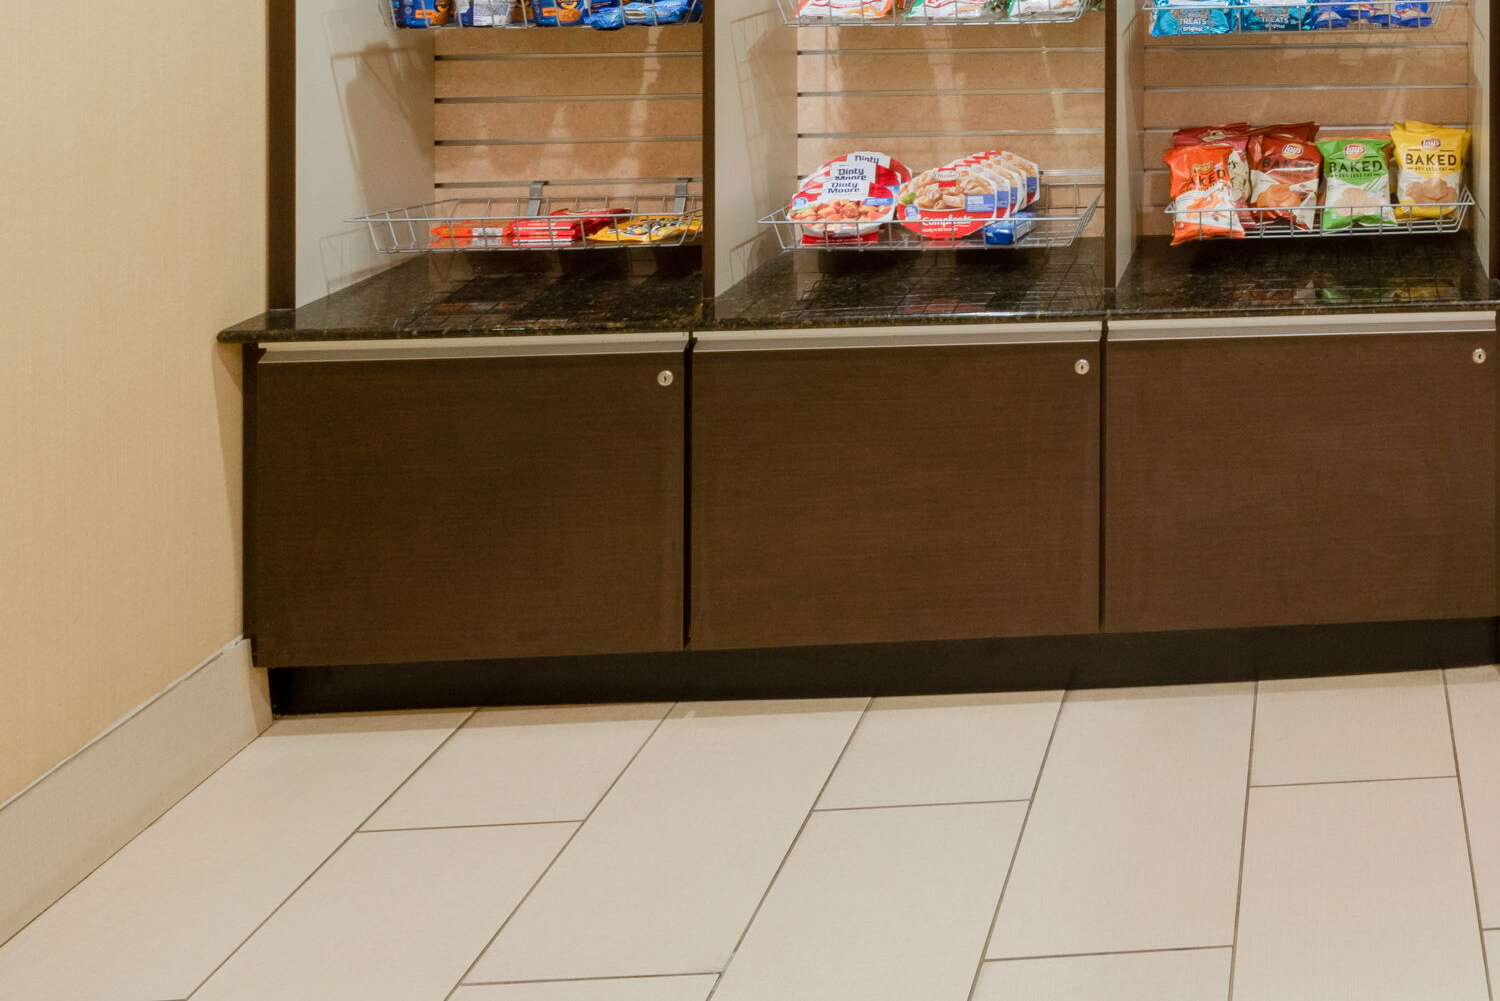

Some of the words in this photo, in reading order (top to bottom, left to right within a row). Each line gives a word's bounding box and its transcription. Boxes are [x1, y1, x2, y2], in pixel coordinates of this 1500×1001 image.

[1405, 154, 1457, 166] BAKED
[838, 168, 864, 176] Dinty
[1328, 160, 1383, 173] BAKED
[1188, 170, 1226, 186] AKED
